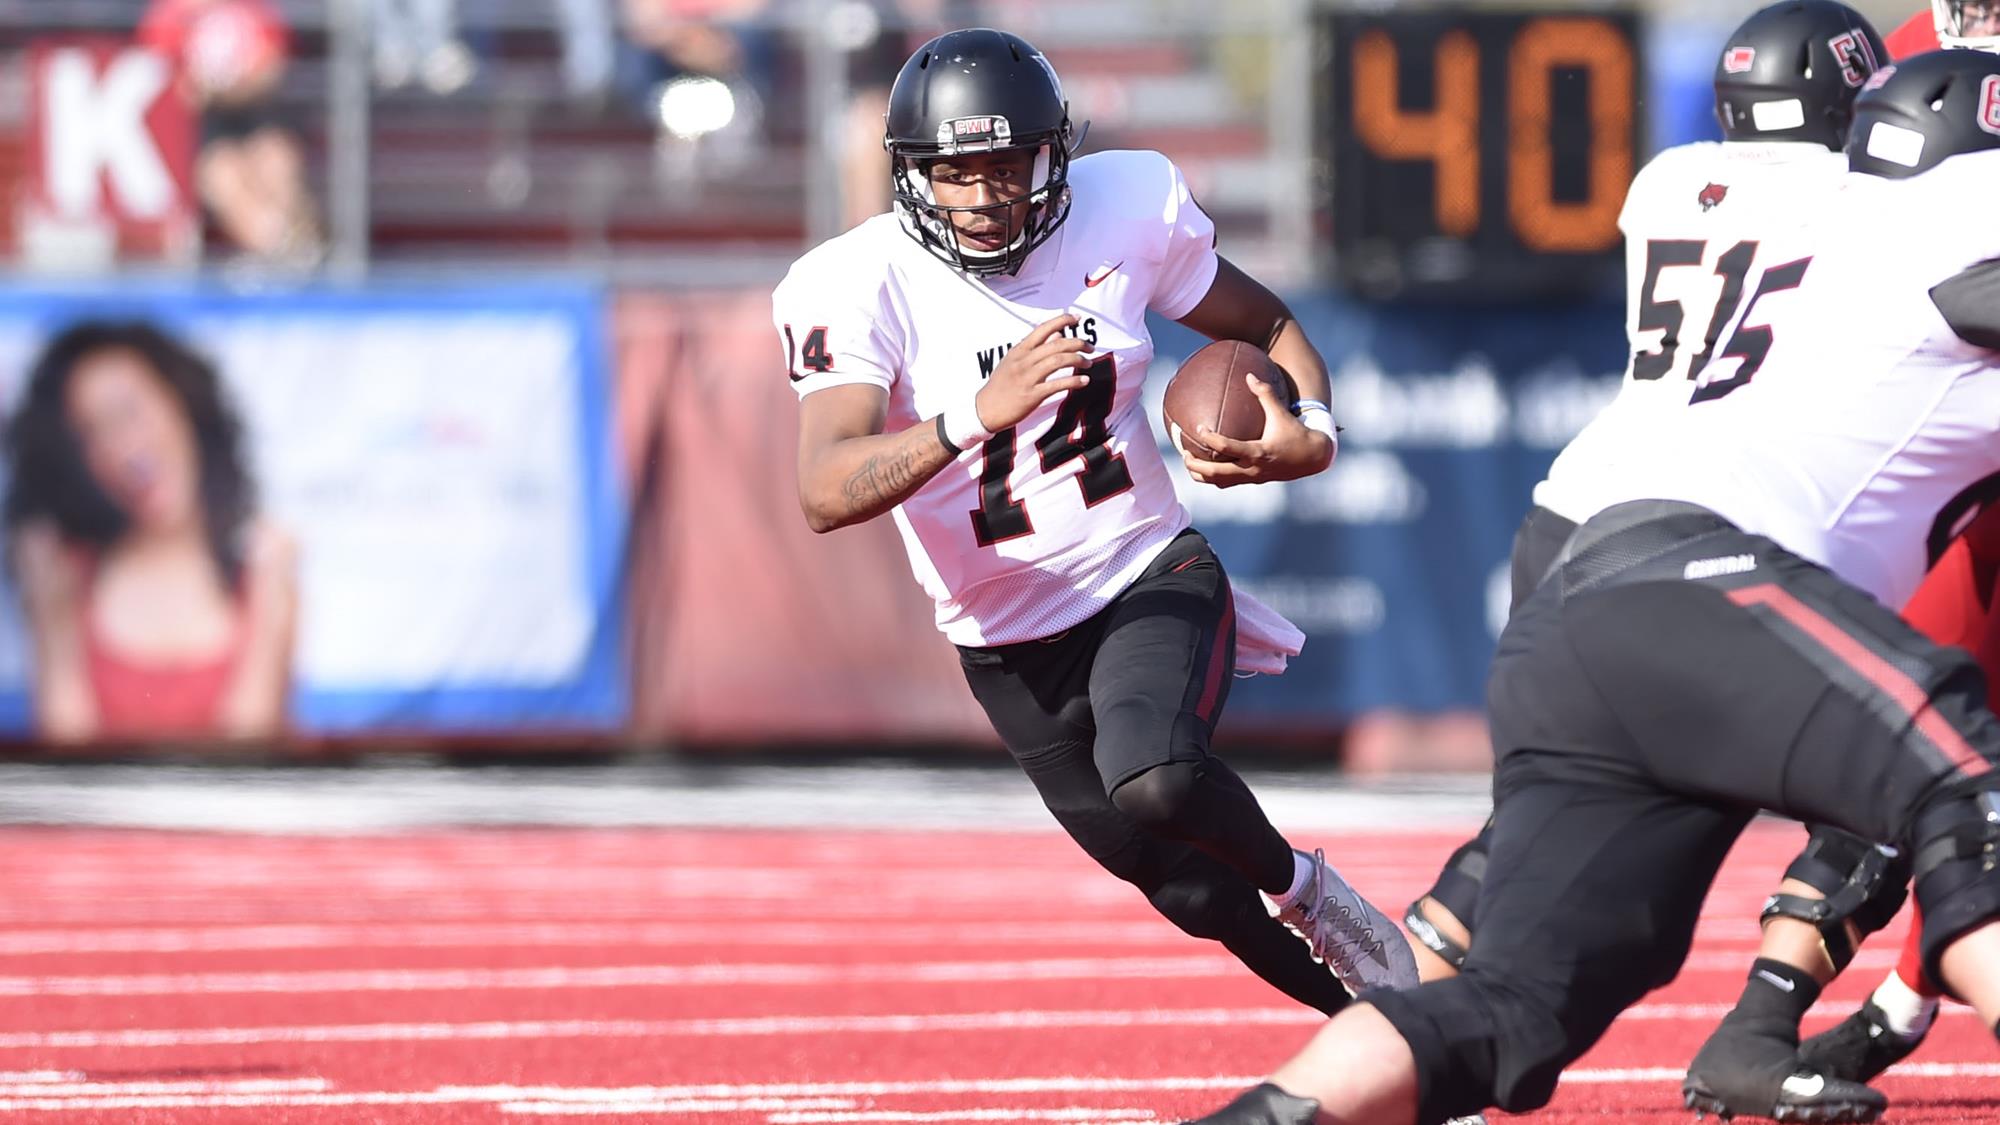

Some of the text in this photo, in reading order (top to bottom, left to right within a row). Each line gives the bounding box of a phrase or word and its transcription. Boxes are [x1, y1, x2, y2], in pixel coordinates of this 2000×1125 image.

[42, 48, 178, 220] K
[954, 117, 993, 135] CWU
[1352, 16, 1634, 252] 40
[784, 323, 834, 382] 14
[1633, 239, 1760, 380] 51
[969, 351, 1135, 548] 14
